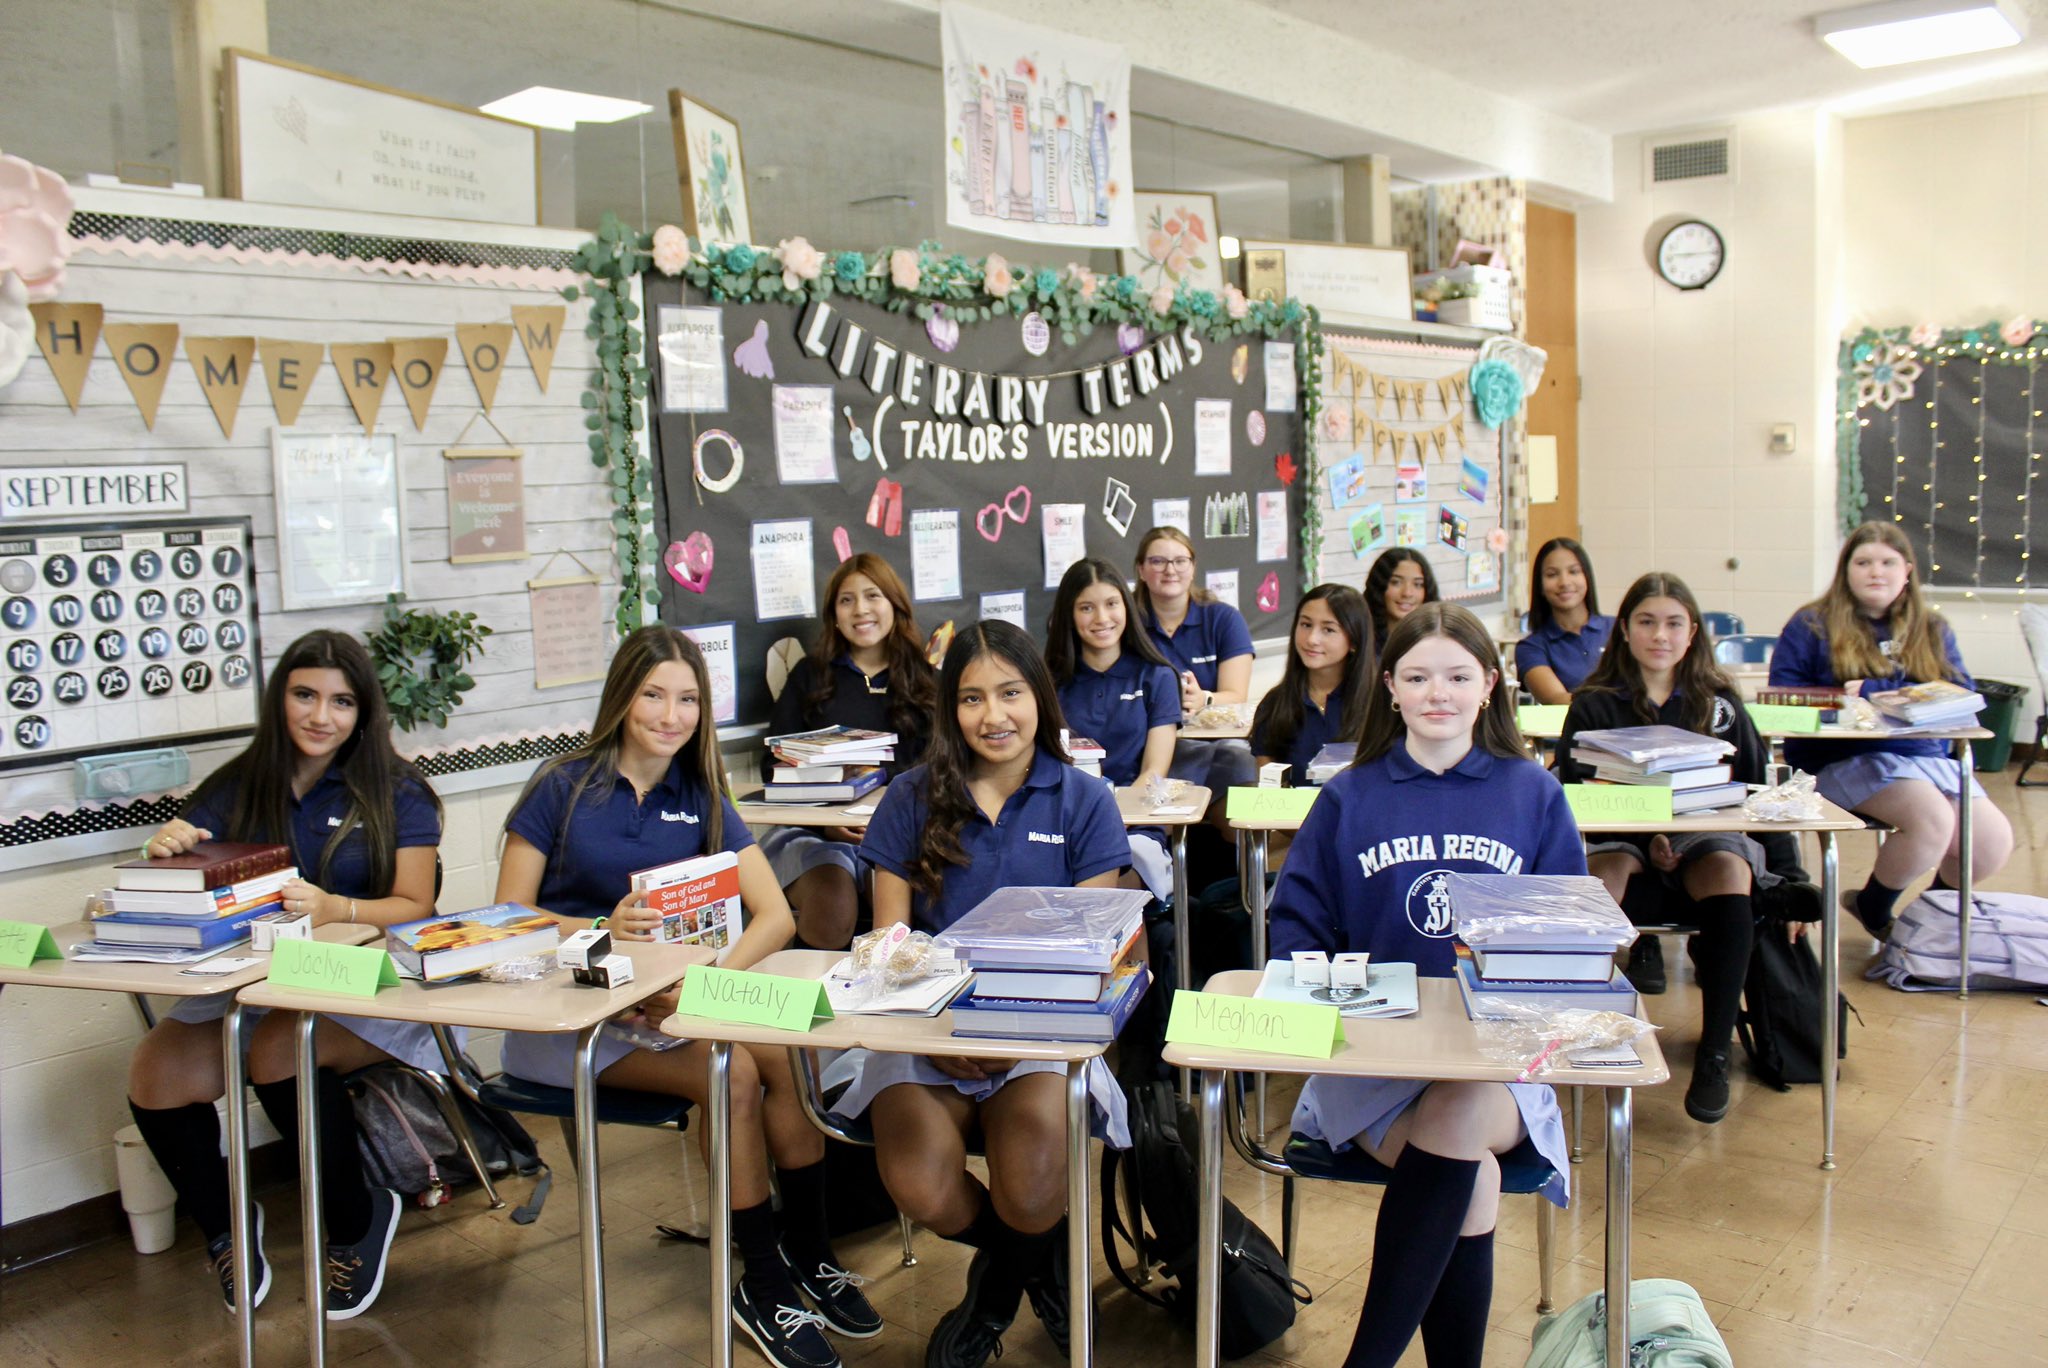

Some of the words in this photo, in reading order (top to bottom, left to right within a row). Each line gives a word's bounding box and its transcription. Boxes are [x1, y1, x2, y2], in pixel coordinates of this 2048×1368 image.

[1013, 105, 1025, 132] RED
[48, 319, 553, 391] HOMEROOM
[805, 302, 1050, 426] LITERARY
[1084, 328, 1203, 415] TERMS
[1338, 360, 1423, 404] VOCAB
[1444, 380, 1465, 402] IN
[1356, 418, 1464, 455] ACTION
[7, 471, 179, 508] SEPTEMBER
[456, 470, 515, 489] Everyone
[479, 487, 491, 498] is
[474, 515, 502, 529] here
[759, 533, 805, 545] ANAPHORA
[53, 557, 68, 581] 3
[97, 559, 111, 581] 4
[139, 554, 154, 578] 5
[180, 551, 194, 574] 6
[221, 550, 232, 574] 7
[13, 601, 26, 624] 9
[53, 600, 79, 623] 10
[97, 595, 117, 618] 11
[139, 594, 163, 616] 12
[181, 594, 201, 616] 13
[216, 589, 238, 610] 14
[13, 644, 37, 667] 16
[56, 638, 79, 661] 17
[99, 634, 121, 656] 18
[143, 632, 167, 654] 19
[182, 628, 206, 648] 20
[223, 626, 242, 647] 21
[11, 682, 39, 705] 23
[58, 676, 83, 698] 24
[100, 671, 128, 694] 25
[145, 669, 171, 690] 26
[186, 667, 209, 686] 27
[225, 661, 247, 682] 28
[19, 721, 46, 744] 30
[1252, 793, 1294, 812] Ava
[1577, 788, 1653, 812] Gianna
[1028, 832, 1051, 844] MARIA
[1357, 834, 1438, 878] MARIA
[1443, 833, 1524, 875] REGINA
[661, 890, 678, 902] Son
[678, 888, 687, 899] of
[688, 883, 702, 894] God
[703, 877, 716, 889] and
[662, 902, 678, 912] Son
[679, 899, 687, 910] of
[689, 892, 708, 905] Mary
[290, 944, 352, 985] Joclyn
[702, 973, 790, 1020] Nataly
[1196, 998, 1289, 1044] Meghan
